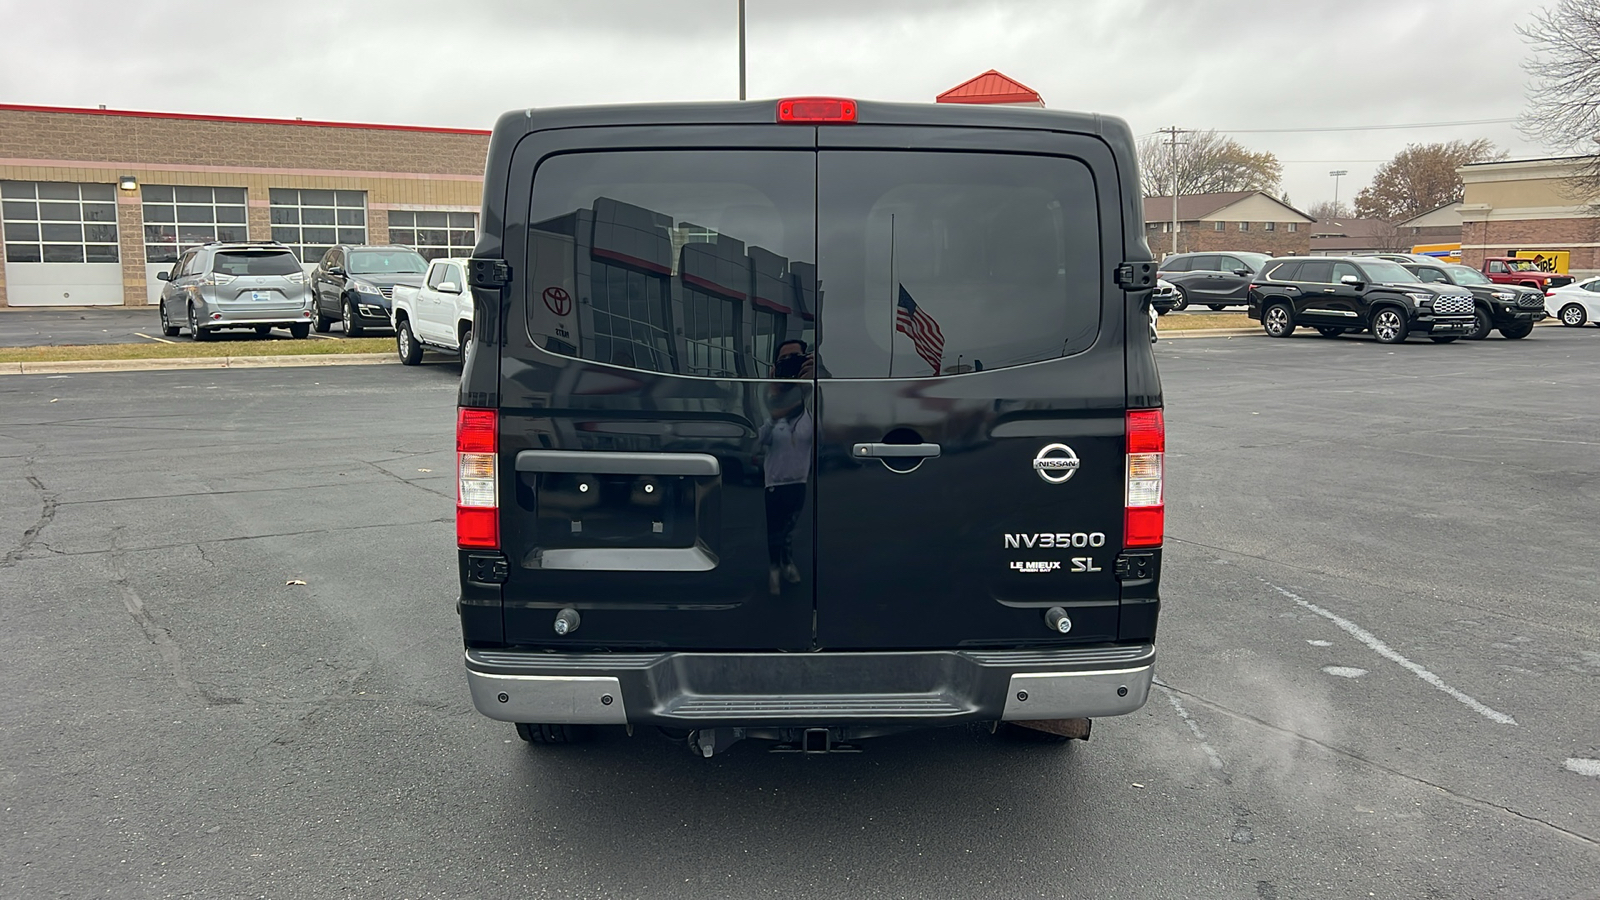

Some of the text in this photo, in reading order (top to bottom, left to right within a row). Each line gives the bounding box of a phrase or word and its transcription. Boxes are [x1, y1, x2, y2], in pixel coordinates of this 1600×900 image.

[1039, 460, 1076, 468] NISSAN
[1004, 532, 1106, 549] NV3500
[1010, 561, 1061, 569] LE MIEUX
[1070, 557, 1102, 572] SL
